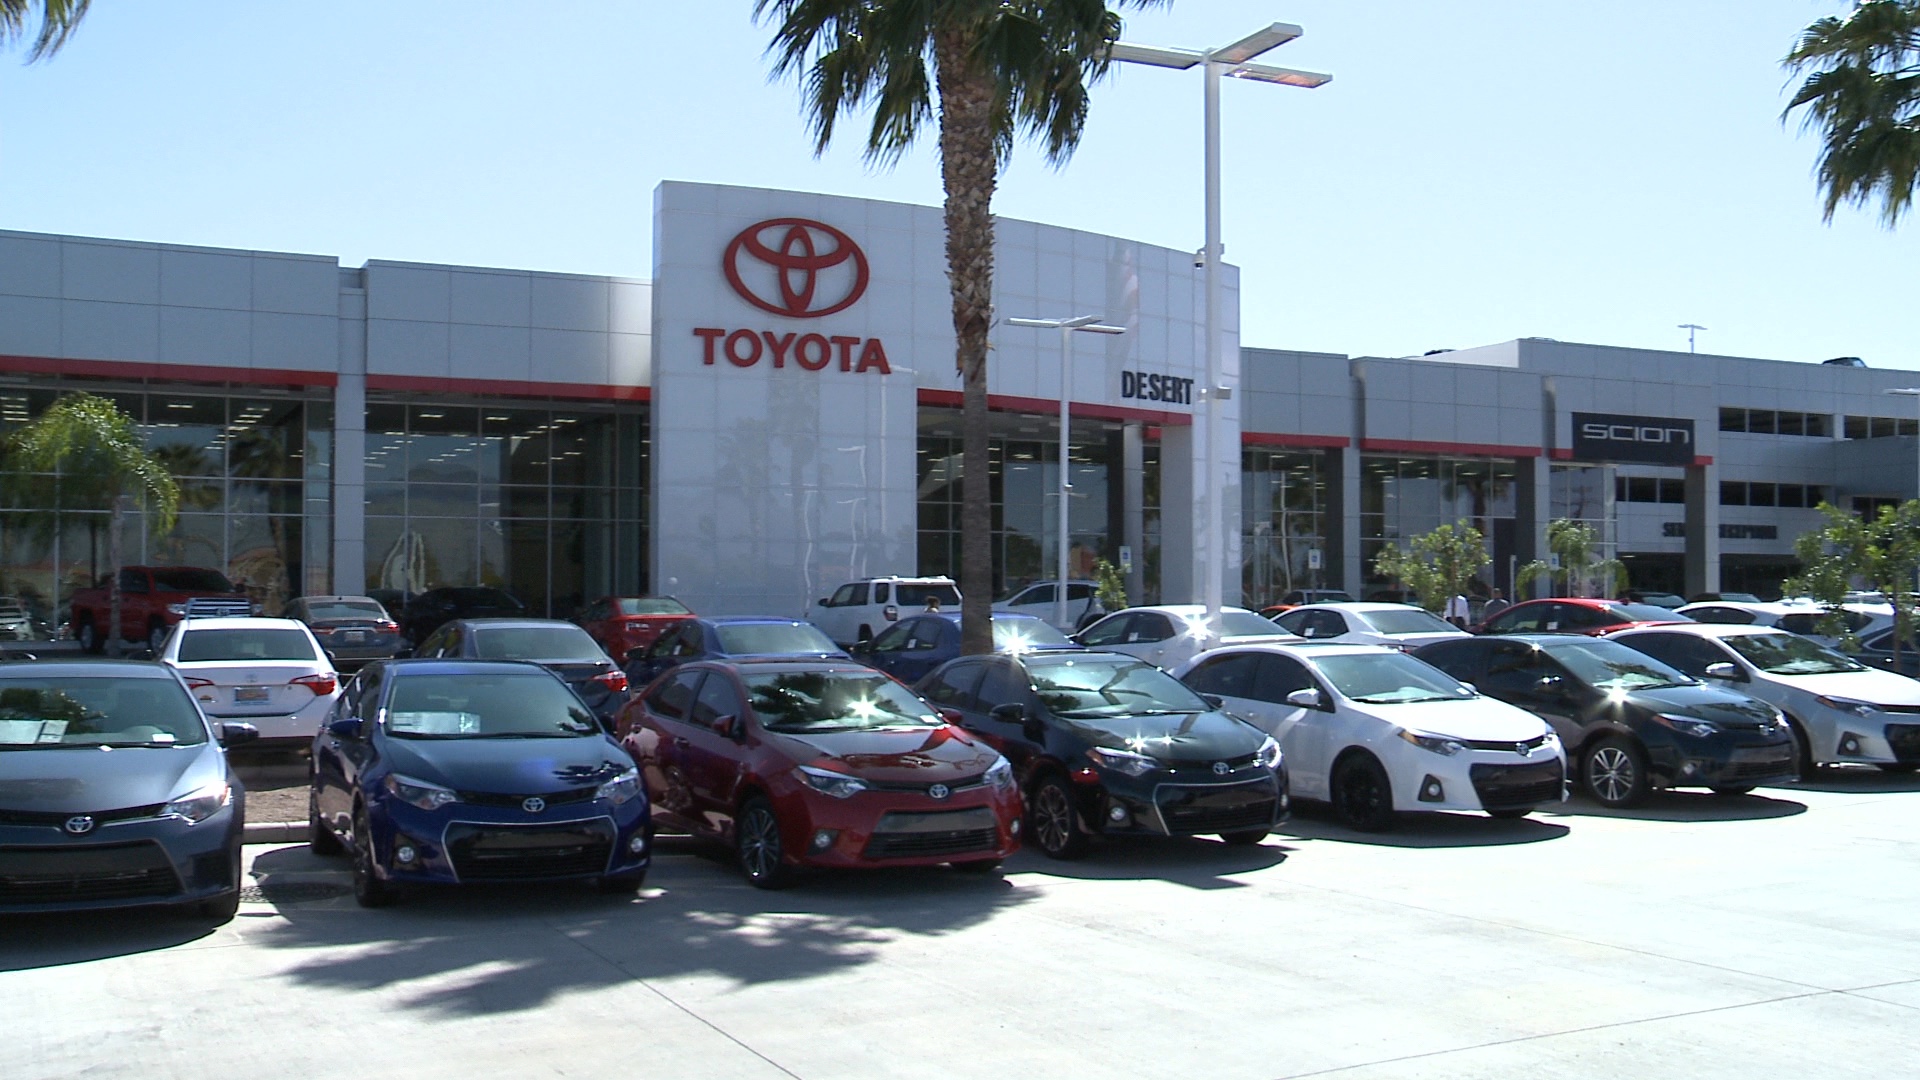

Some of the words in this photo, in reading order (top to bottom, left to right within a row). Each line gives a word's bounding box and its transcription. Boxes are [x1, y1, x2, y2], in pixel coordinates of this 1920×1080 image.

[694, 328, 891, 374] TOYOTA
[1121, 370, 1194, 405] DESERT
[1582, 423, 1690, 444] SCION
